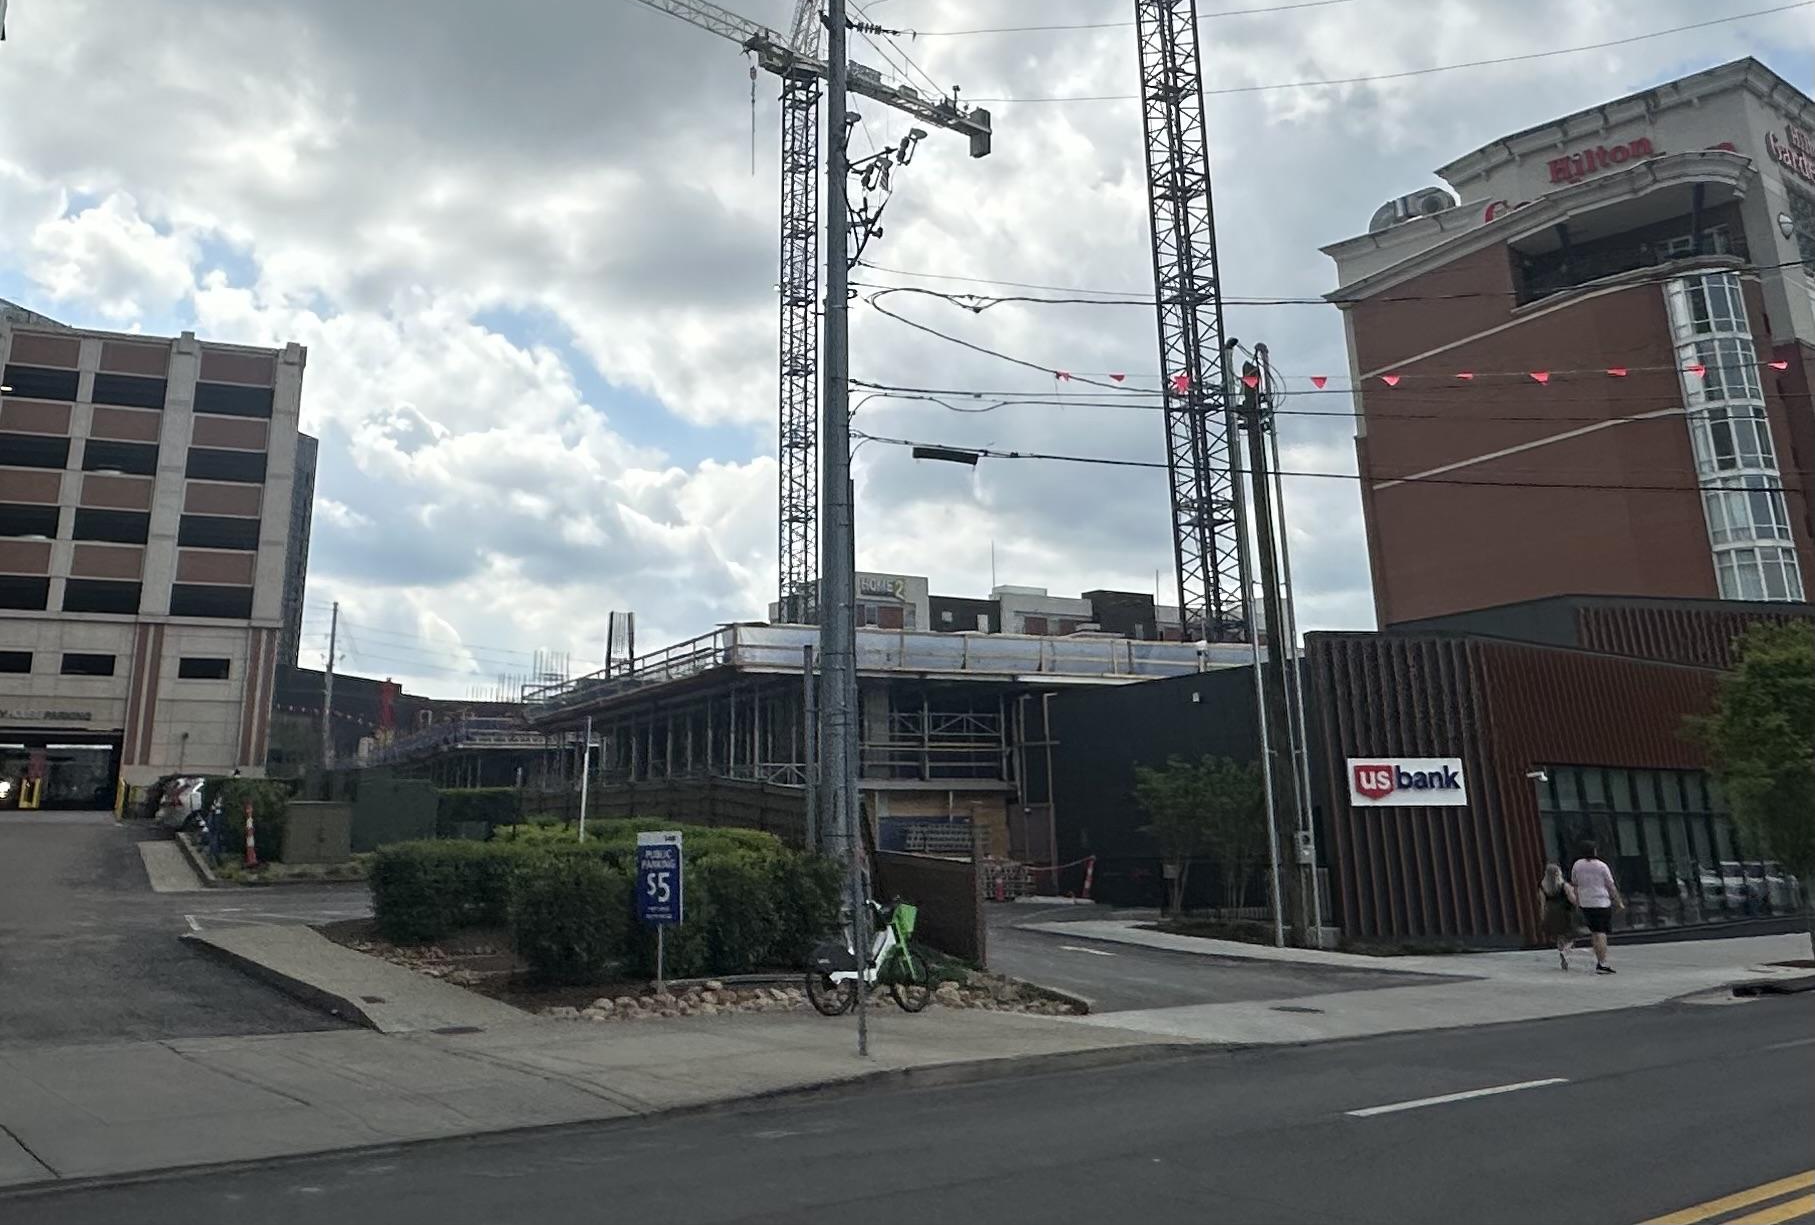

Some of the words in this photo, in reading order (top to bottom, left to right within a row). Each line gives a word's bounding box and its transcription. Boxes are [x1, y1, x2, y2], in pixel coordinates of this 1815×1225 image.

[1547, 136, 1654, 184] Hilton
[1395, 765, 1460, 789] bank
[640, 858, 676, 869] PARKING
